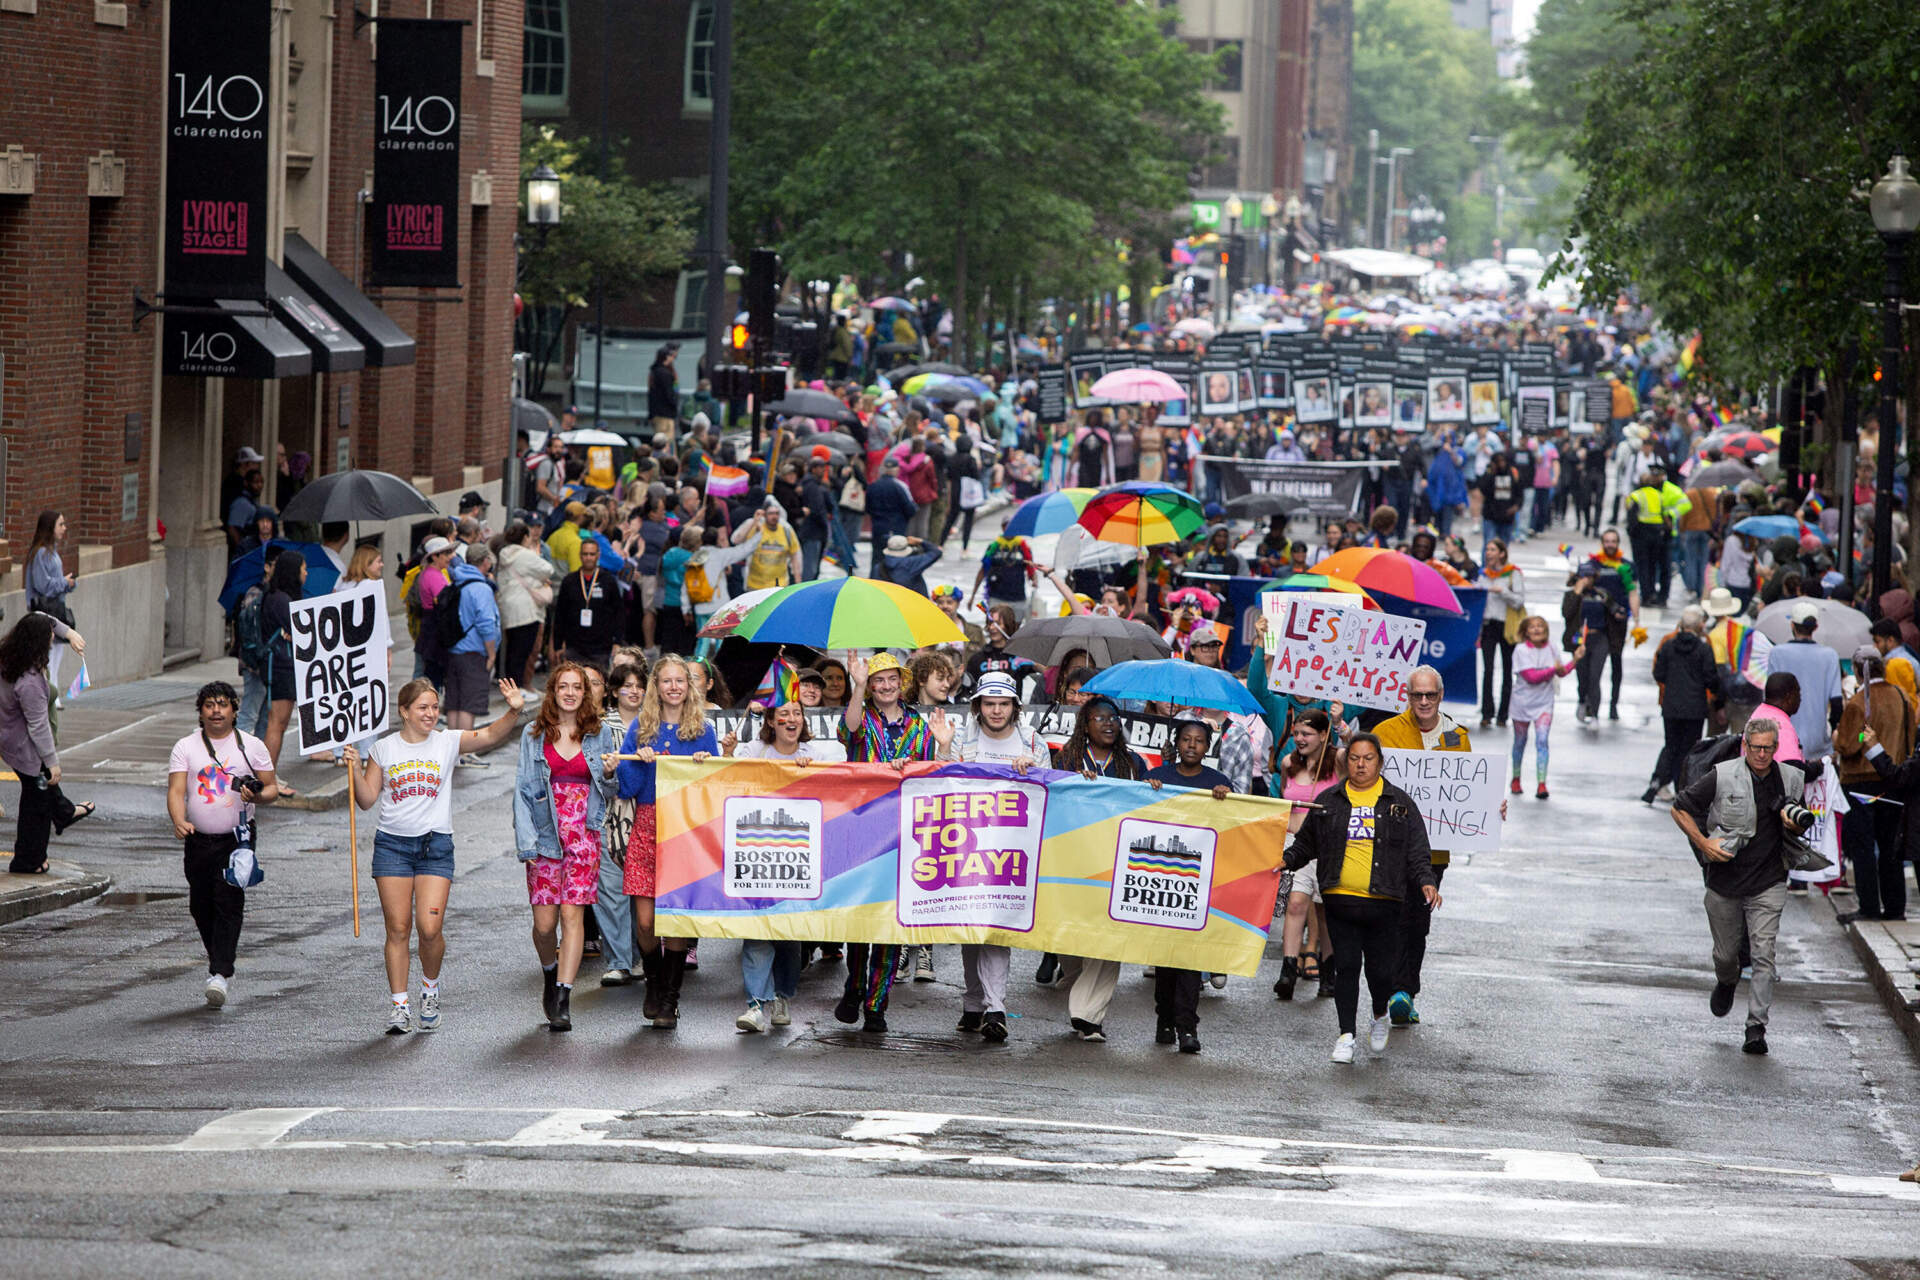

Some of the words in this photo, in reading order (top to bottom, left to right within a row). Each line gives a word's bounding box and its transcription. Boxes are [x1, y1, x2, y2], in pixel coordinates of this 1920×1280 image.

[175, 73, 263, 121] 140
[379, 95, 455, 136] 140
[174, 124, 262, 139] clarendon
[379, 139, 454, 150] clarendon
[183, 200, 236, 232] LYRIC
[387, 204, 432, 231] LYRIC
[183, 233, 236, 248] STAGE
[387, 232, 432, 245] STAGE
[181, 331, 236, 362] 140
[180, 363, 235, 372] clarendon
[292, 594, 375, 662] YOU
[1285, 601, 1419, 662] LESBIAN
[306, 647, 368, 699] ARE
[1277, 646, 1409, 702] APOCALYPSE
[299, 679, 386, 748] LOVED
[319, 691, 353, 719] SO
[389, 770, 442, 790] Reebok
[1384, 755, 1488, 784] AMERICA
[1404, 783, 1431, 801] HAS
[1439, 784, 1471, 802] NO
[914, 793, 1020, 823] HERE
[1429, 808, 1487, 836] ING!
[914, 823, 968, 851] TO
[734, 851, 810, 863] BOSTON
[913, 851, 1021, 882] STAY!
[734, 864, 811, 880] PRIDE
[1125, 874, 1199, 894] BOSTON
[912, 897, 944, 906] BOSTON
[912, 906, 947, 916] PARADE
[948, 903, 968, 911] AND
[970, 901, 1009, 911] FESTIVAL
[1120, 904, 1139, 913] FOR
[1141, 907, 1160, 916] THE
[1162, 909, 1198, 920] PEOPLE
[1121, 887, 1198, 911] PRIDE
